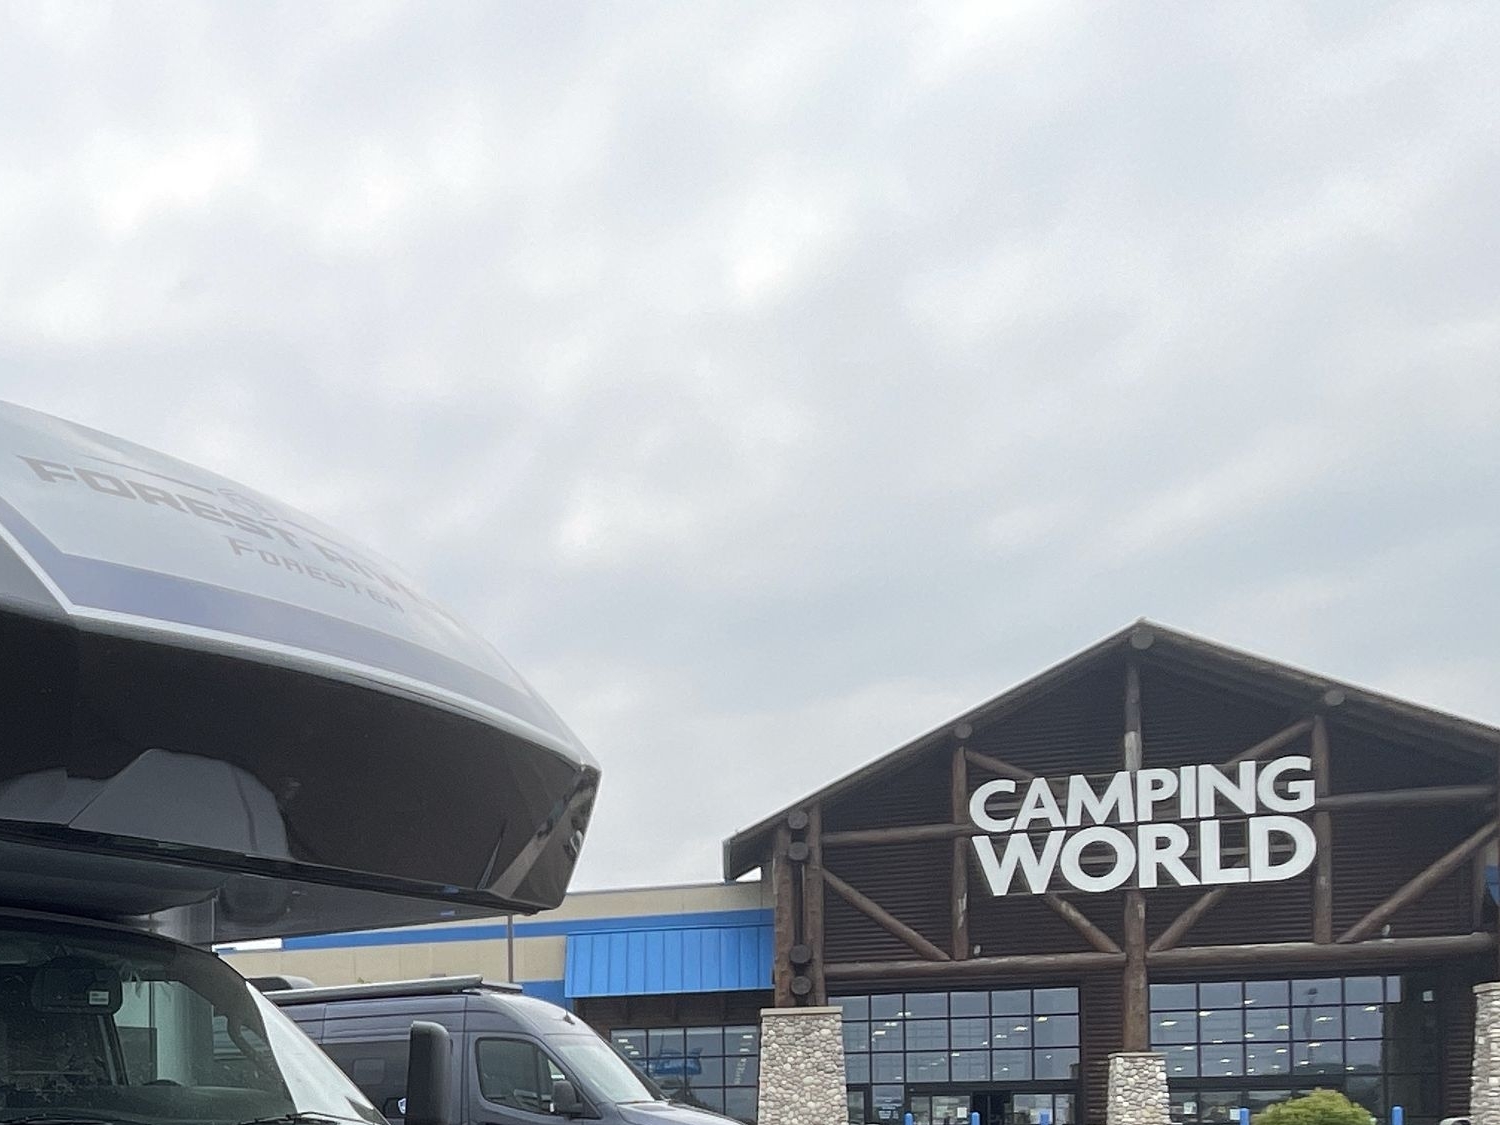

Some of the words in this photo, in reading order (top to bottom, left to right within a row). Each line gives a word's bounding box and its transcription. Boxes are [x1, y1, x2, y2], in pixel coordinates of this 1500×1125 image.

[15, 454, 300, 549] FOREST
[226, 535, 405, 613] FORESTER
[969, 756, 1315, 832] CAMPING
[972, 816, 1317, 896] WORLD
